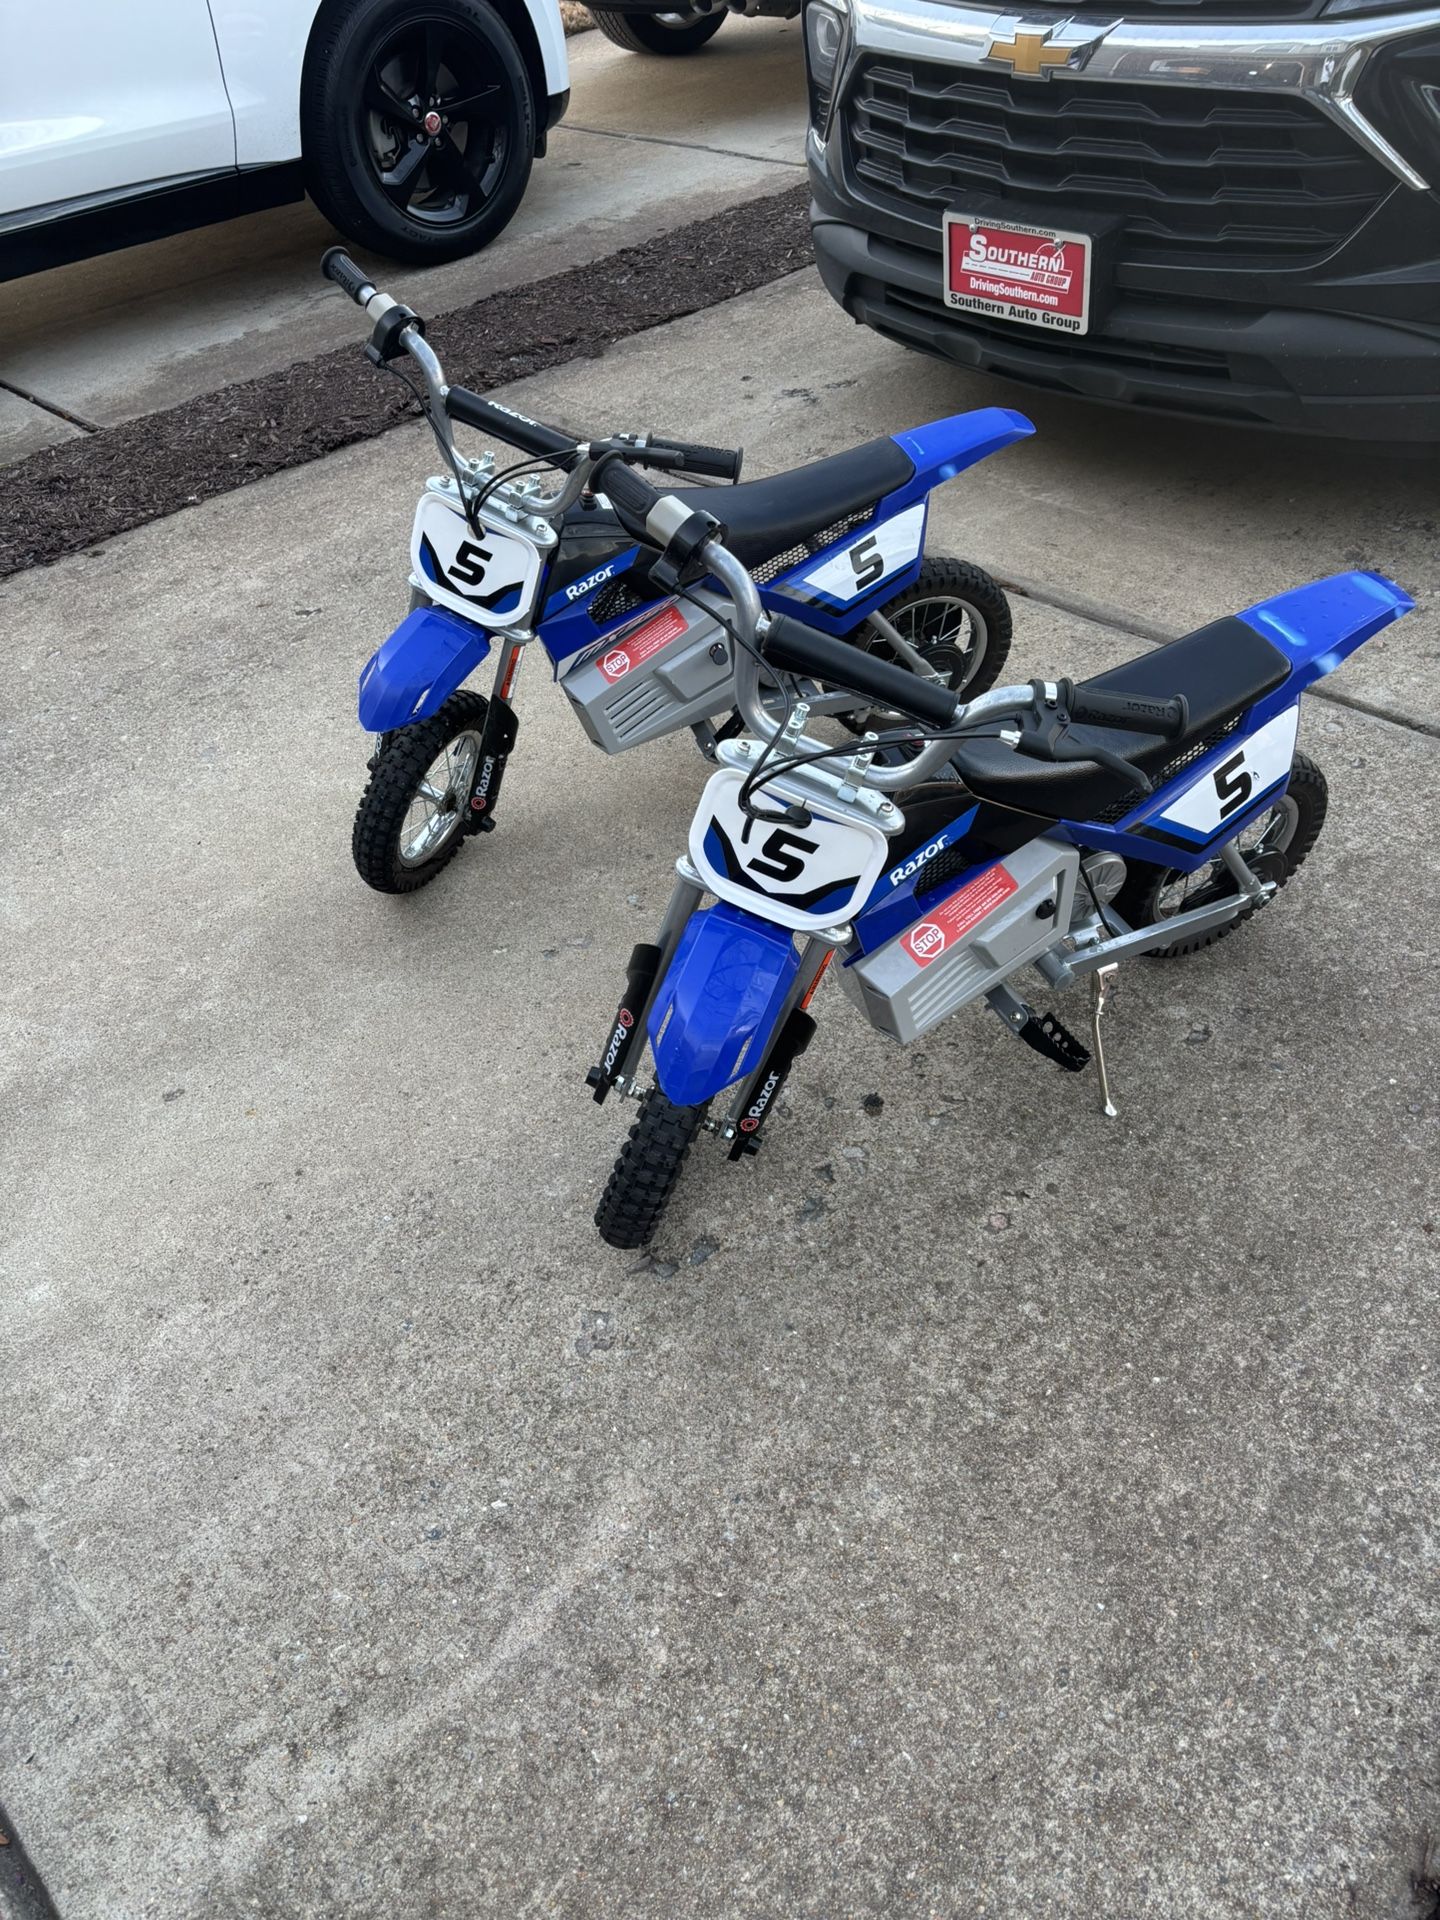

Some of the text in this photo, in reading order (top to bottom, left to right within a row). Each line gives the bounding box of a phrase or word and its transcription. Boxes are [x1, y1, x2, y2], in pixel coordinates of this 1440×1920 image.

[974, 217, 1056, 238] DrivingSouthern.com
[969, 276, 1058, 306] DrivingSouthern.com
[1030, 271, 1067, 287] AUTO GROUP
[950, 293, 1081, 332] Southern Auto Group
[447, 540, 493, 586] 5
[565, 565, 614, 600] Razor
[849, 535, 884, 591] 5
[605, 654, 627, 673] STOP
[475, 755, 496, 797] Razor
[1213, 750, 1252, 820] 5
[746, 827, 820, 883] 5
[889, 834, 948, 886] Razor
[914, 928, 940, 953] STOP
[603, 1022, 628, 1076] Razor
[749, 1071, 782, 1118] Razor
